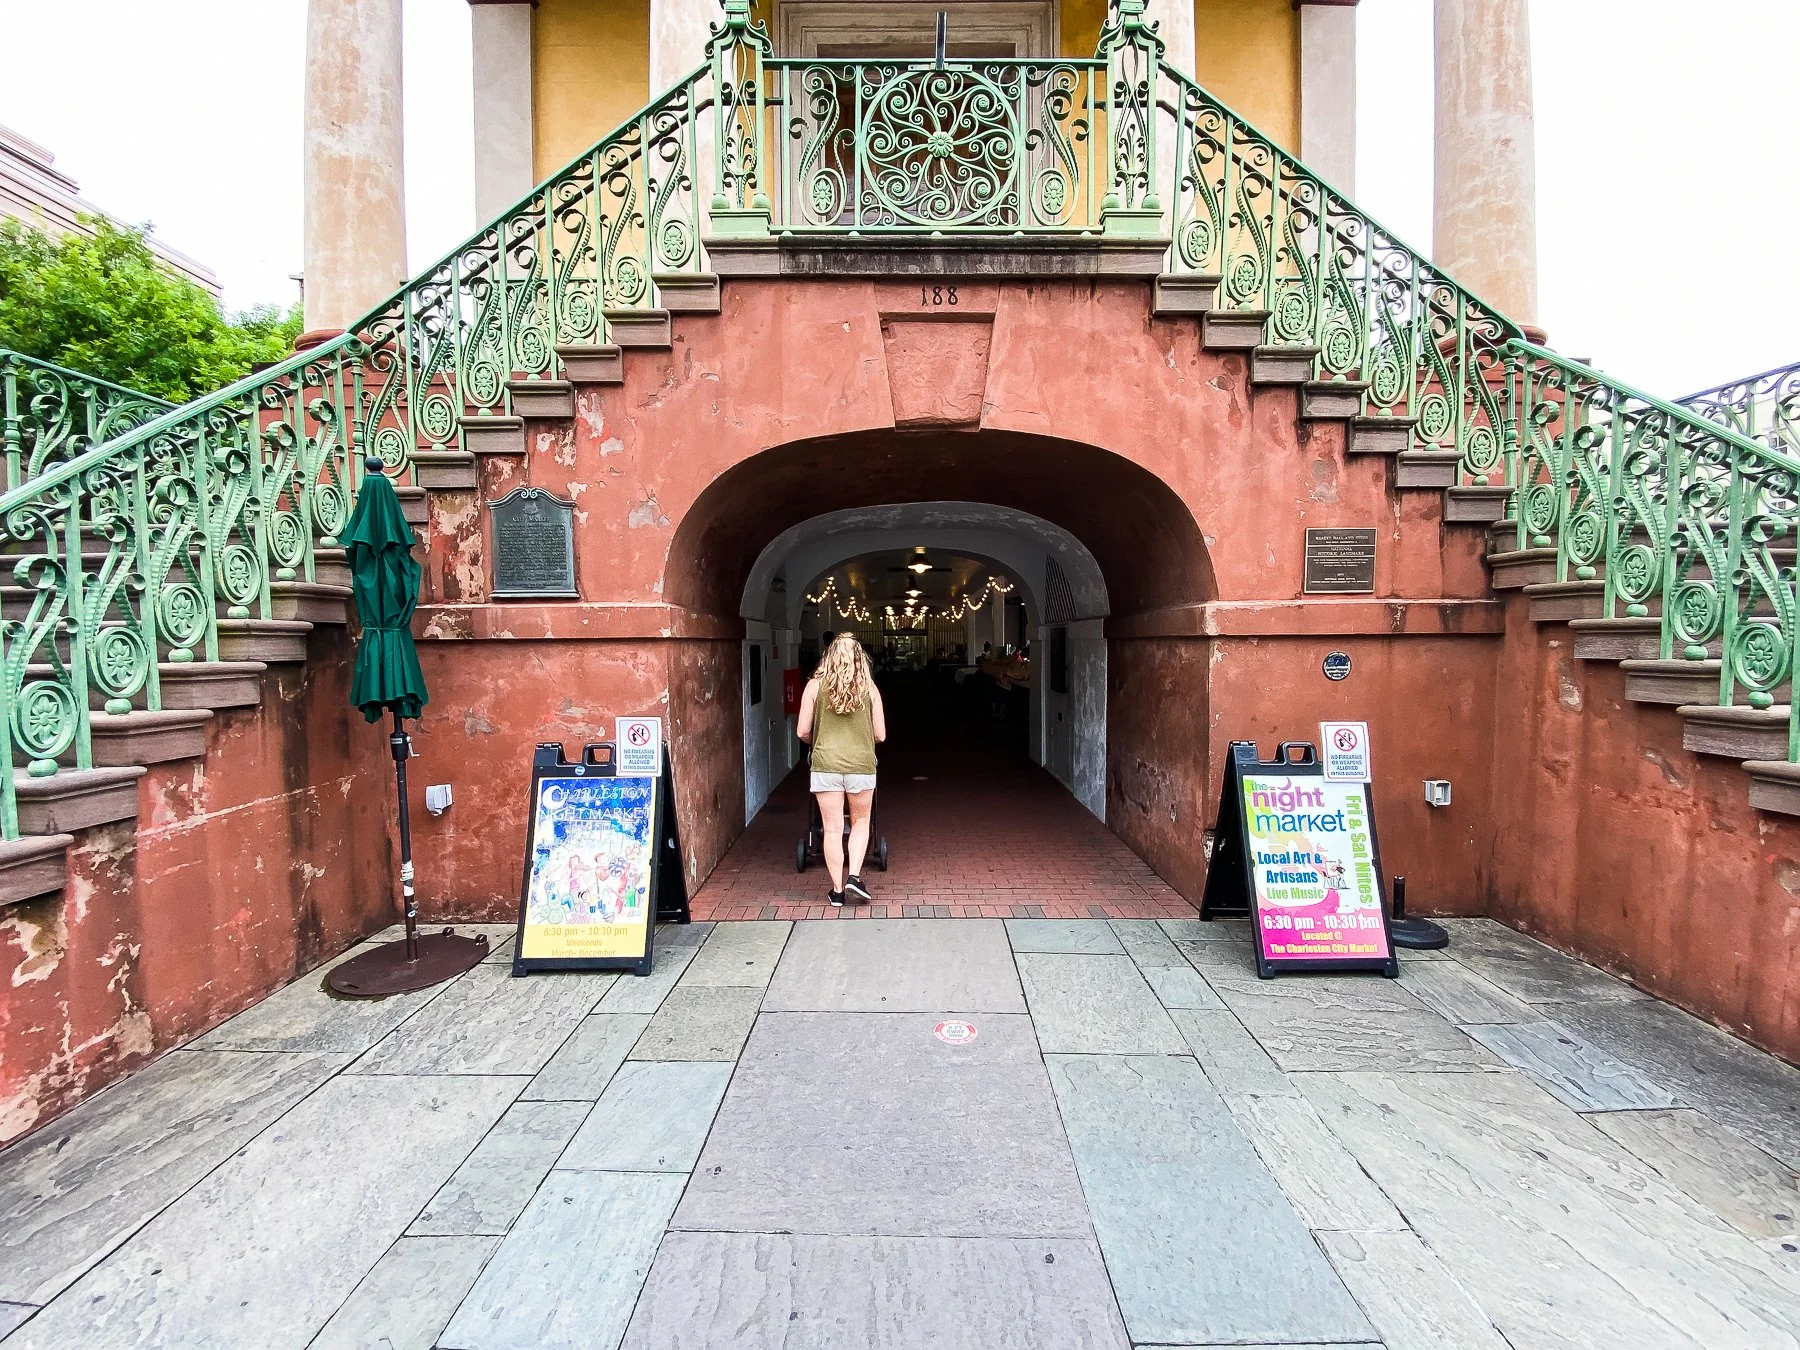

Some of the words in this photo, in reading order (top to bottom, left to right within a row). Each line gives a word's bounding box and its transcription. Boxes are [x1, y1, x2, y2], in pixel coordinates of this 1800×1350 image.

[921, 285, 959, 306] 188
[1251, 780, 1268, 791] the
[1252, 786, 1326, 812] night
[541, 808, 586, 820] NIGHT
[589, 807, 651, 820] MARKET
[1345, 795, 1364, 818] Fri
[1255, 809, 1347, 832] market
[1348, 819, 1363, 830] &
[1349, 833, 1368, 858] Sat
[1257, 851, 1291, 865] Local
[1293, 850, 1312, 865] Art
[1314, 853, 1323, 864] &
[1266, 869, 1319, 884] Artisans
[1352, 862, 1374, 904] Nites
[1266, 887, 1289, 900] Live
[1291, 886, 1325, 899] Music
[1263, 915, 1293, 930] 6:30
[1294, 917, 1315, 932] pm
[1323, 914, 1358, 930] 10:30
[543, 927, 563, 936] 6:30
[564, 928, 578, 938] pm
[588, 926, 613, 936] 10:30
[614, 927, 628, 938] pm
[1301, 930, 1334, 941] Located
[566, 938, 603, 947] Weekends
[1270, 943, 1285, 954] The
[1286, 943, 1331, 954] Charleston
[1332, 942, 1348, 956] City
[1349, 942, 1378, 953] Market
[579, 948, 617, 957] December
